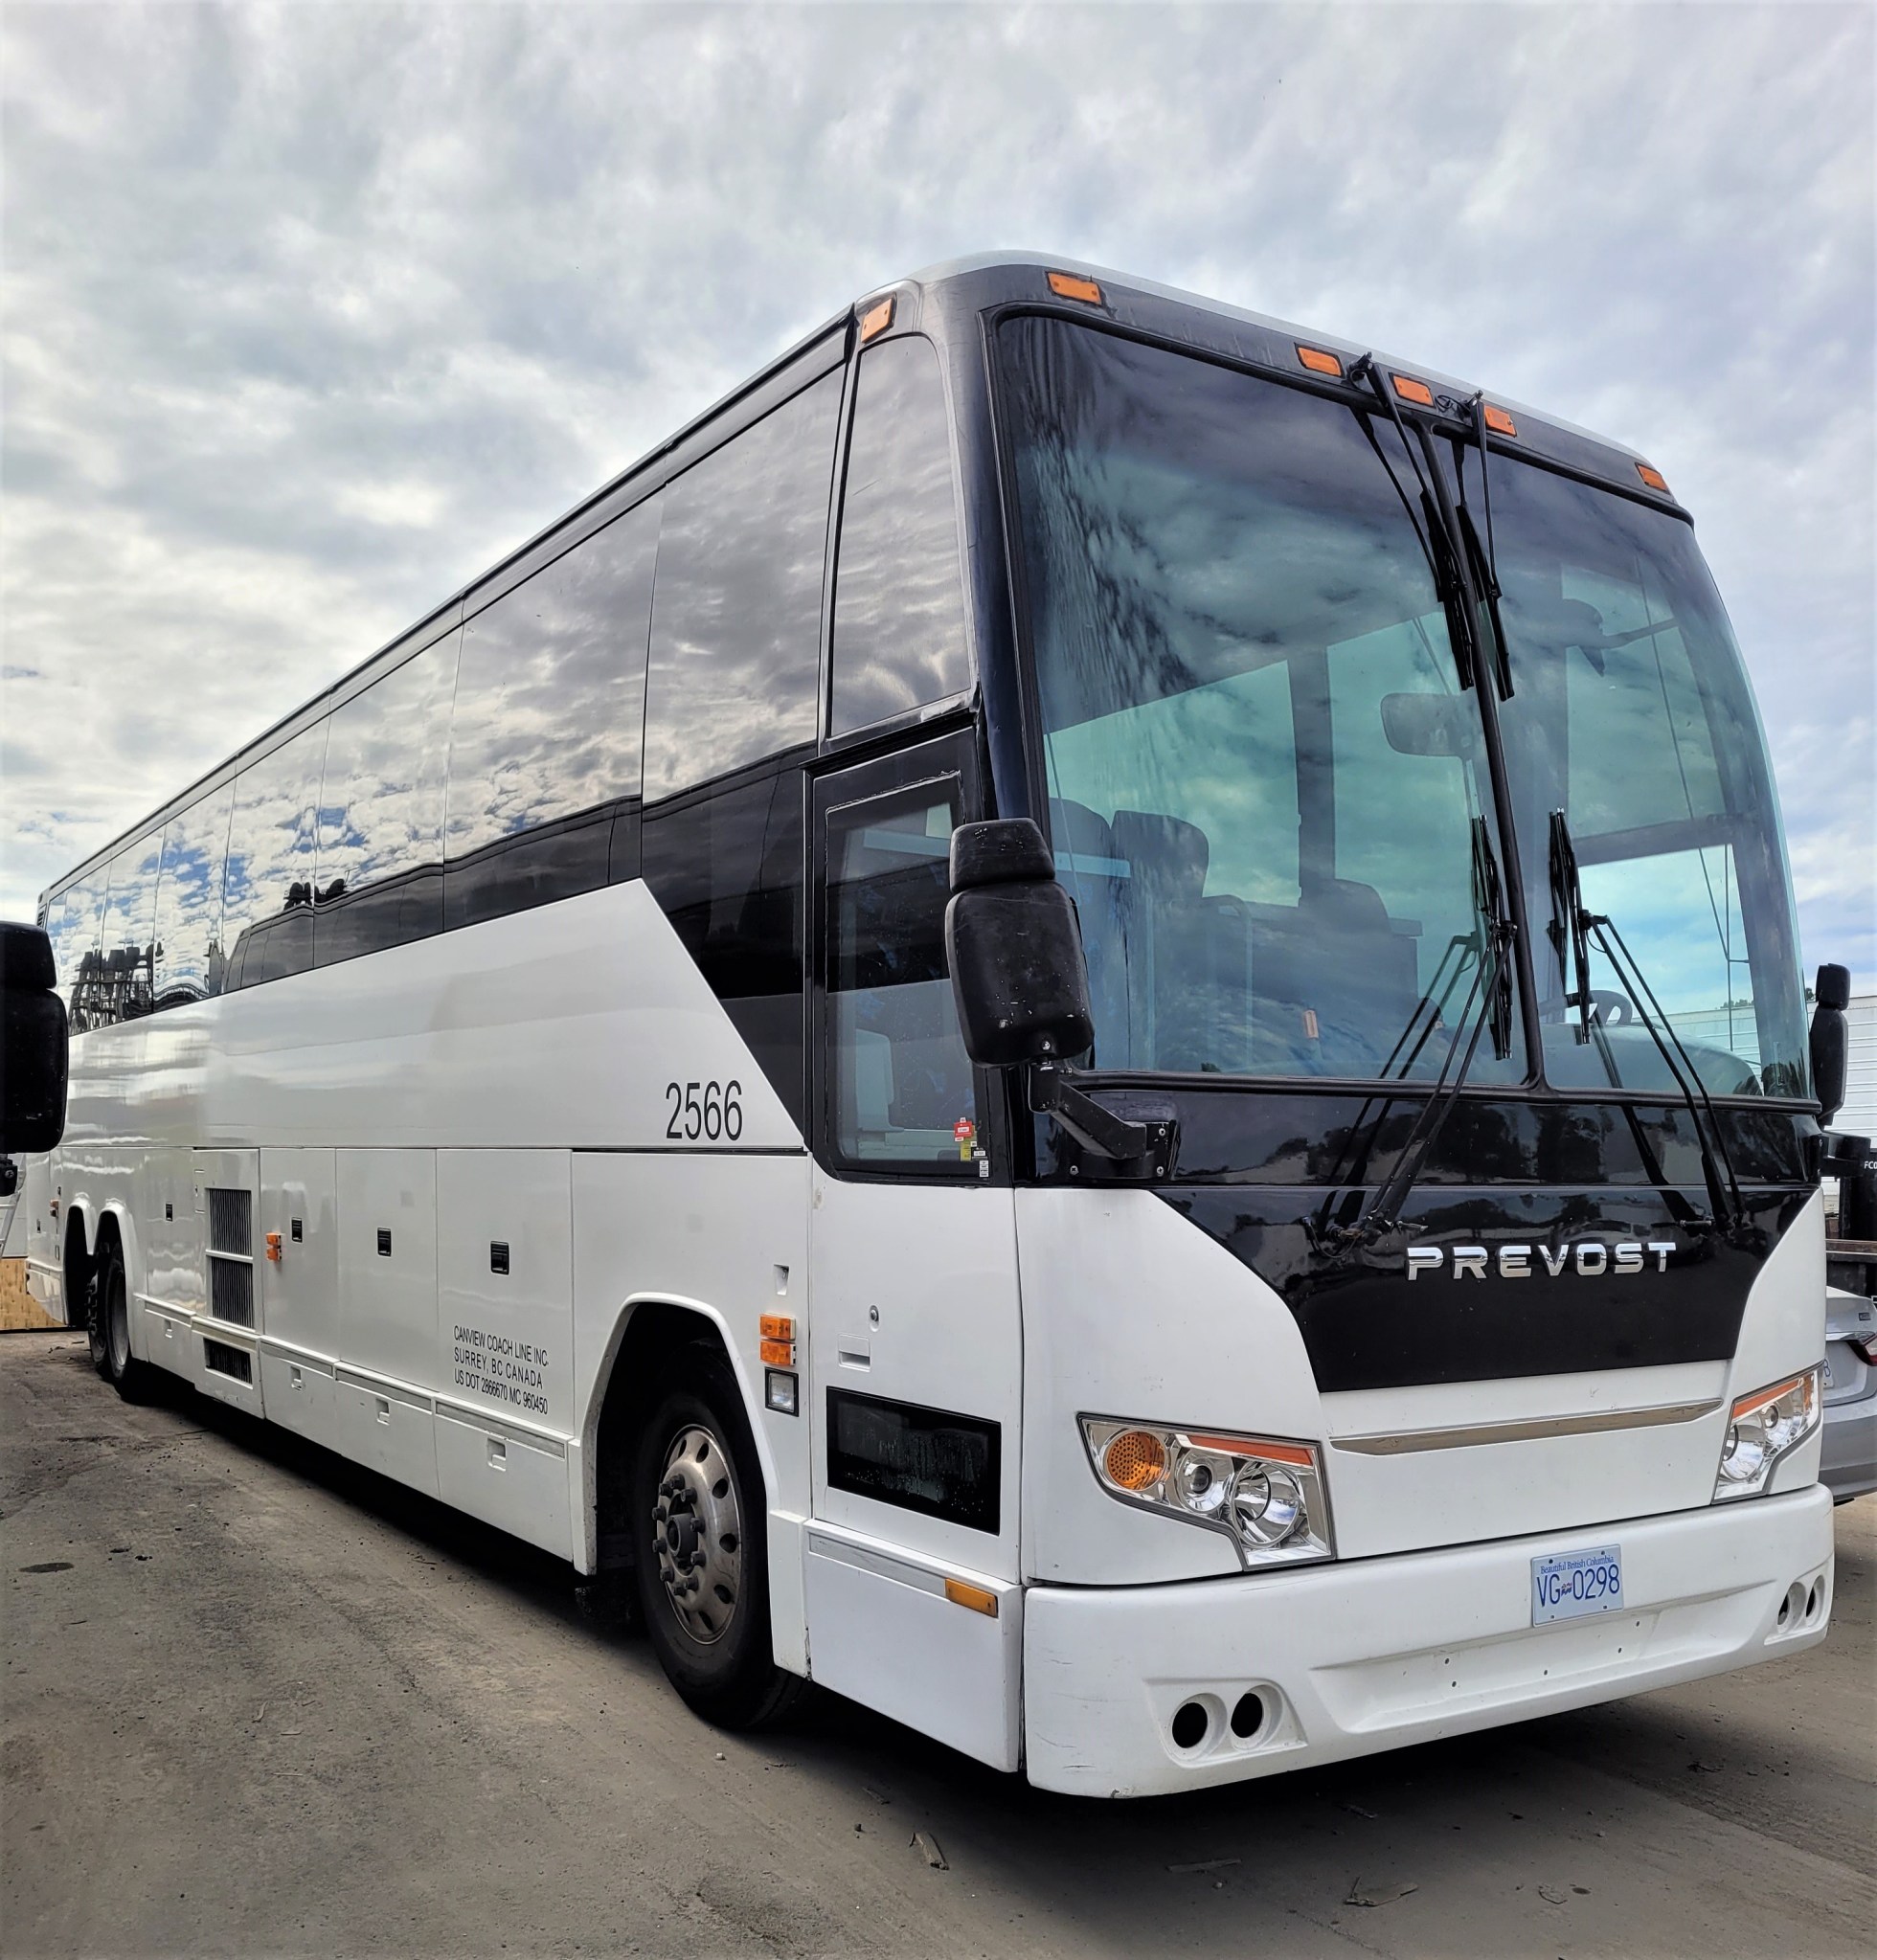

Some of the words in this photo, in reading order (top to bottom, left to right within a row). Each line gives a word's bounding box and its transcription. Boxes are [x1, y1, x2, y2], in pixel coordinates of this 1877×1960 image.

[666, 1080, 742, 1140] 2566
[1406, 1242, 1676, 1281] PREVOST
[454, 1325, 486, 1348] CANVIEW
[486, 1335, 512, 1357] COACH
[514, 1341, 531, 1363] LINE
[454, 1346, 489, 1374] SURREY,
[491, 1358, 503, 1376] BC
[506, 1363, 543, 1389] CANADA
[454, 1367, 464, 1385] US
[465, 1372, 479, 1390] DOT
[509, 1386, 521, 1405] MC
[523, 1391, 548, 1414] 960450
[1540, 1563, 1566, 1574] Beautiful
[1567, 1560, 1586, 1570] British
[1586, 1555, 1615, 1567] Columbia
